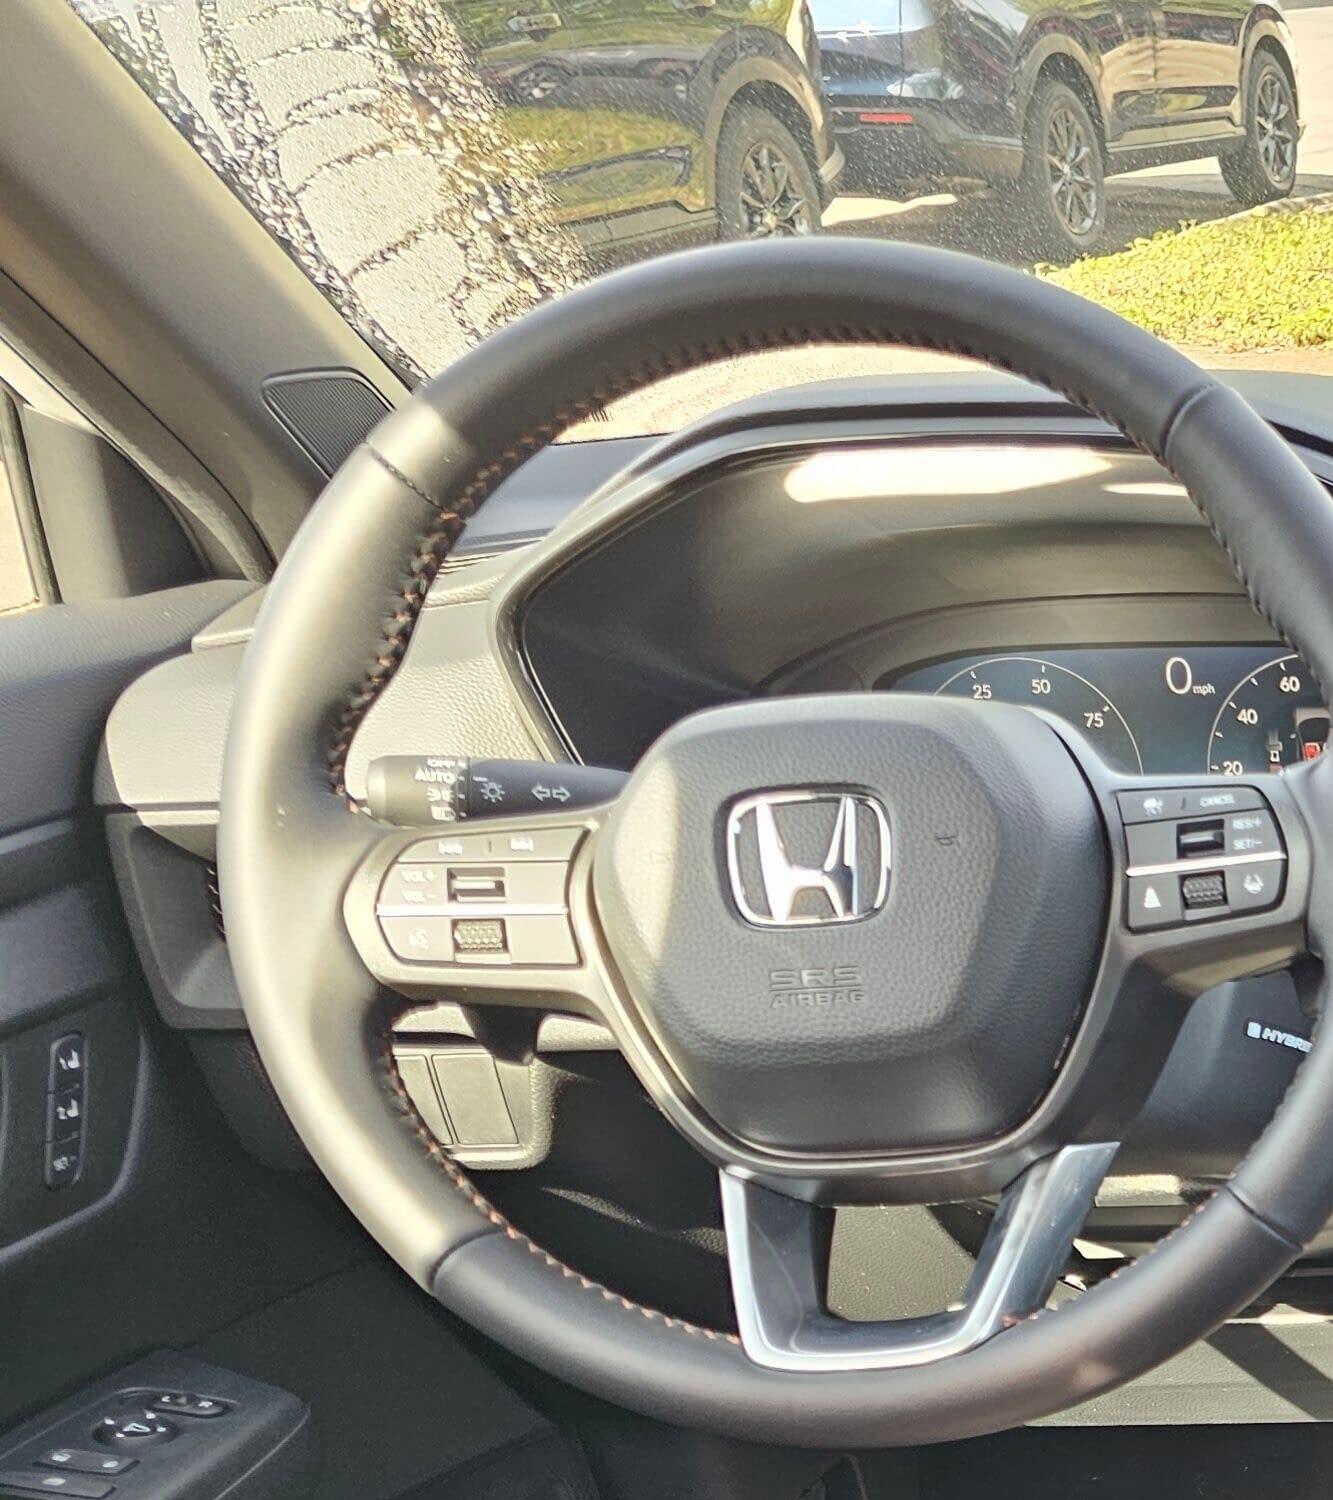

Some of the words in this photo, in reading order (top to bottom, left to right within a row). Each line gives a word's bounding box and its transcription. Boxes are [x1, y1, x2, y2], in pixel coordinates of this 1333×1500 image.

[1165, 656, 1192, 694] 0
[1192, 683, 1215, 697] mph
[1279, 676, 1300, 693] 60
[973, 684, 992, 699] 25
[1031, 679, 1050, 695] 50
[1083, 713, 1103, 728] 75
[1237, 709, 1258, 725] 40
[415, 768, 457, 783] AUTO
[1223, 761, 1242, 776] 20
[769, 965, 861, 989] SRS
[770, 992, 865, 1009] AIRBAG
